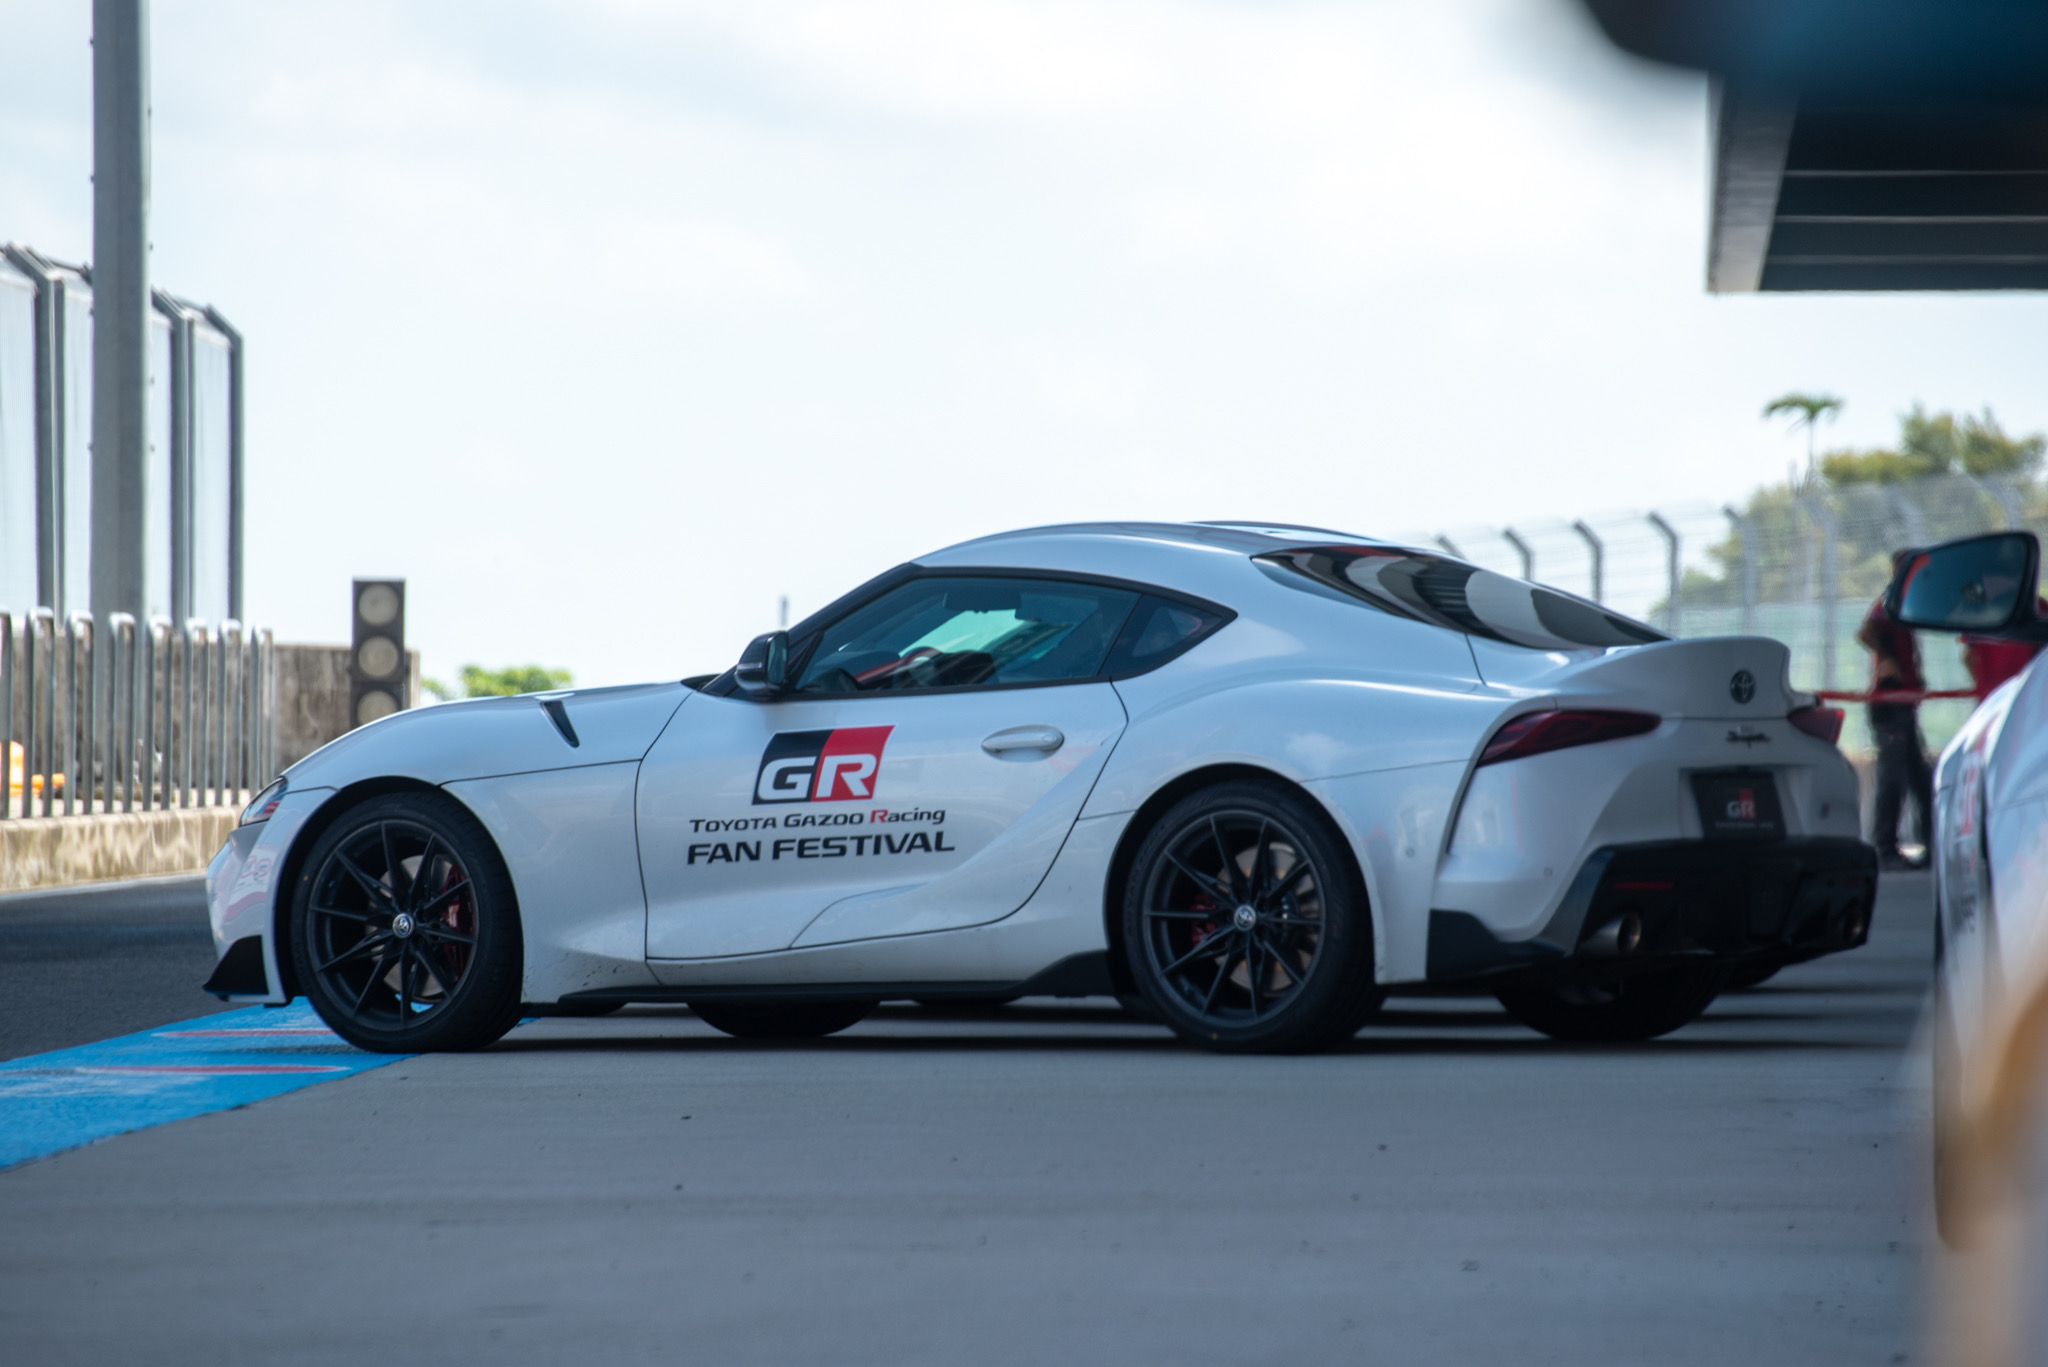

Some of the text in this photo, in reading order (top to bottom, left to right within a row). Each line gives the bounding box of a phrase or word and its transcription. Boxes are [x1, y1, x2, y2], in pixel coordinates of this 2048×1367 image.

[757, 753, 877, 801] GR
[689, 807, 946, 833] TOYOTA GAZOO Racing
[1727, 801, 1755, 819] GR
[687, 831, 956, 865] FAN FESTIVAL
